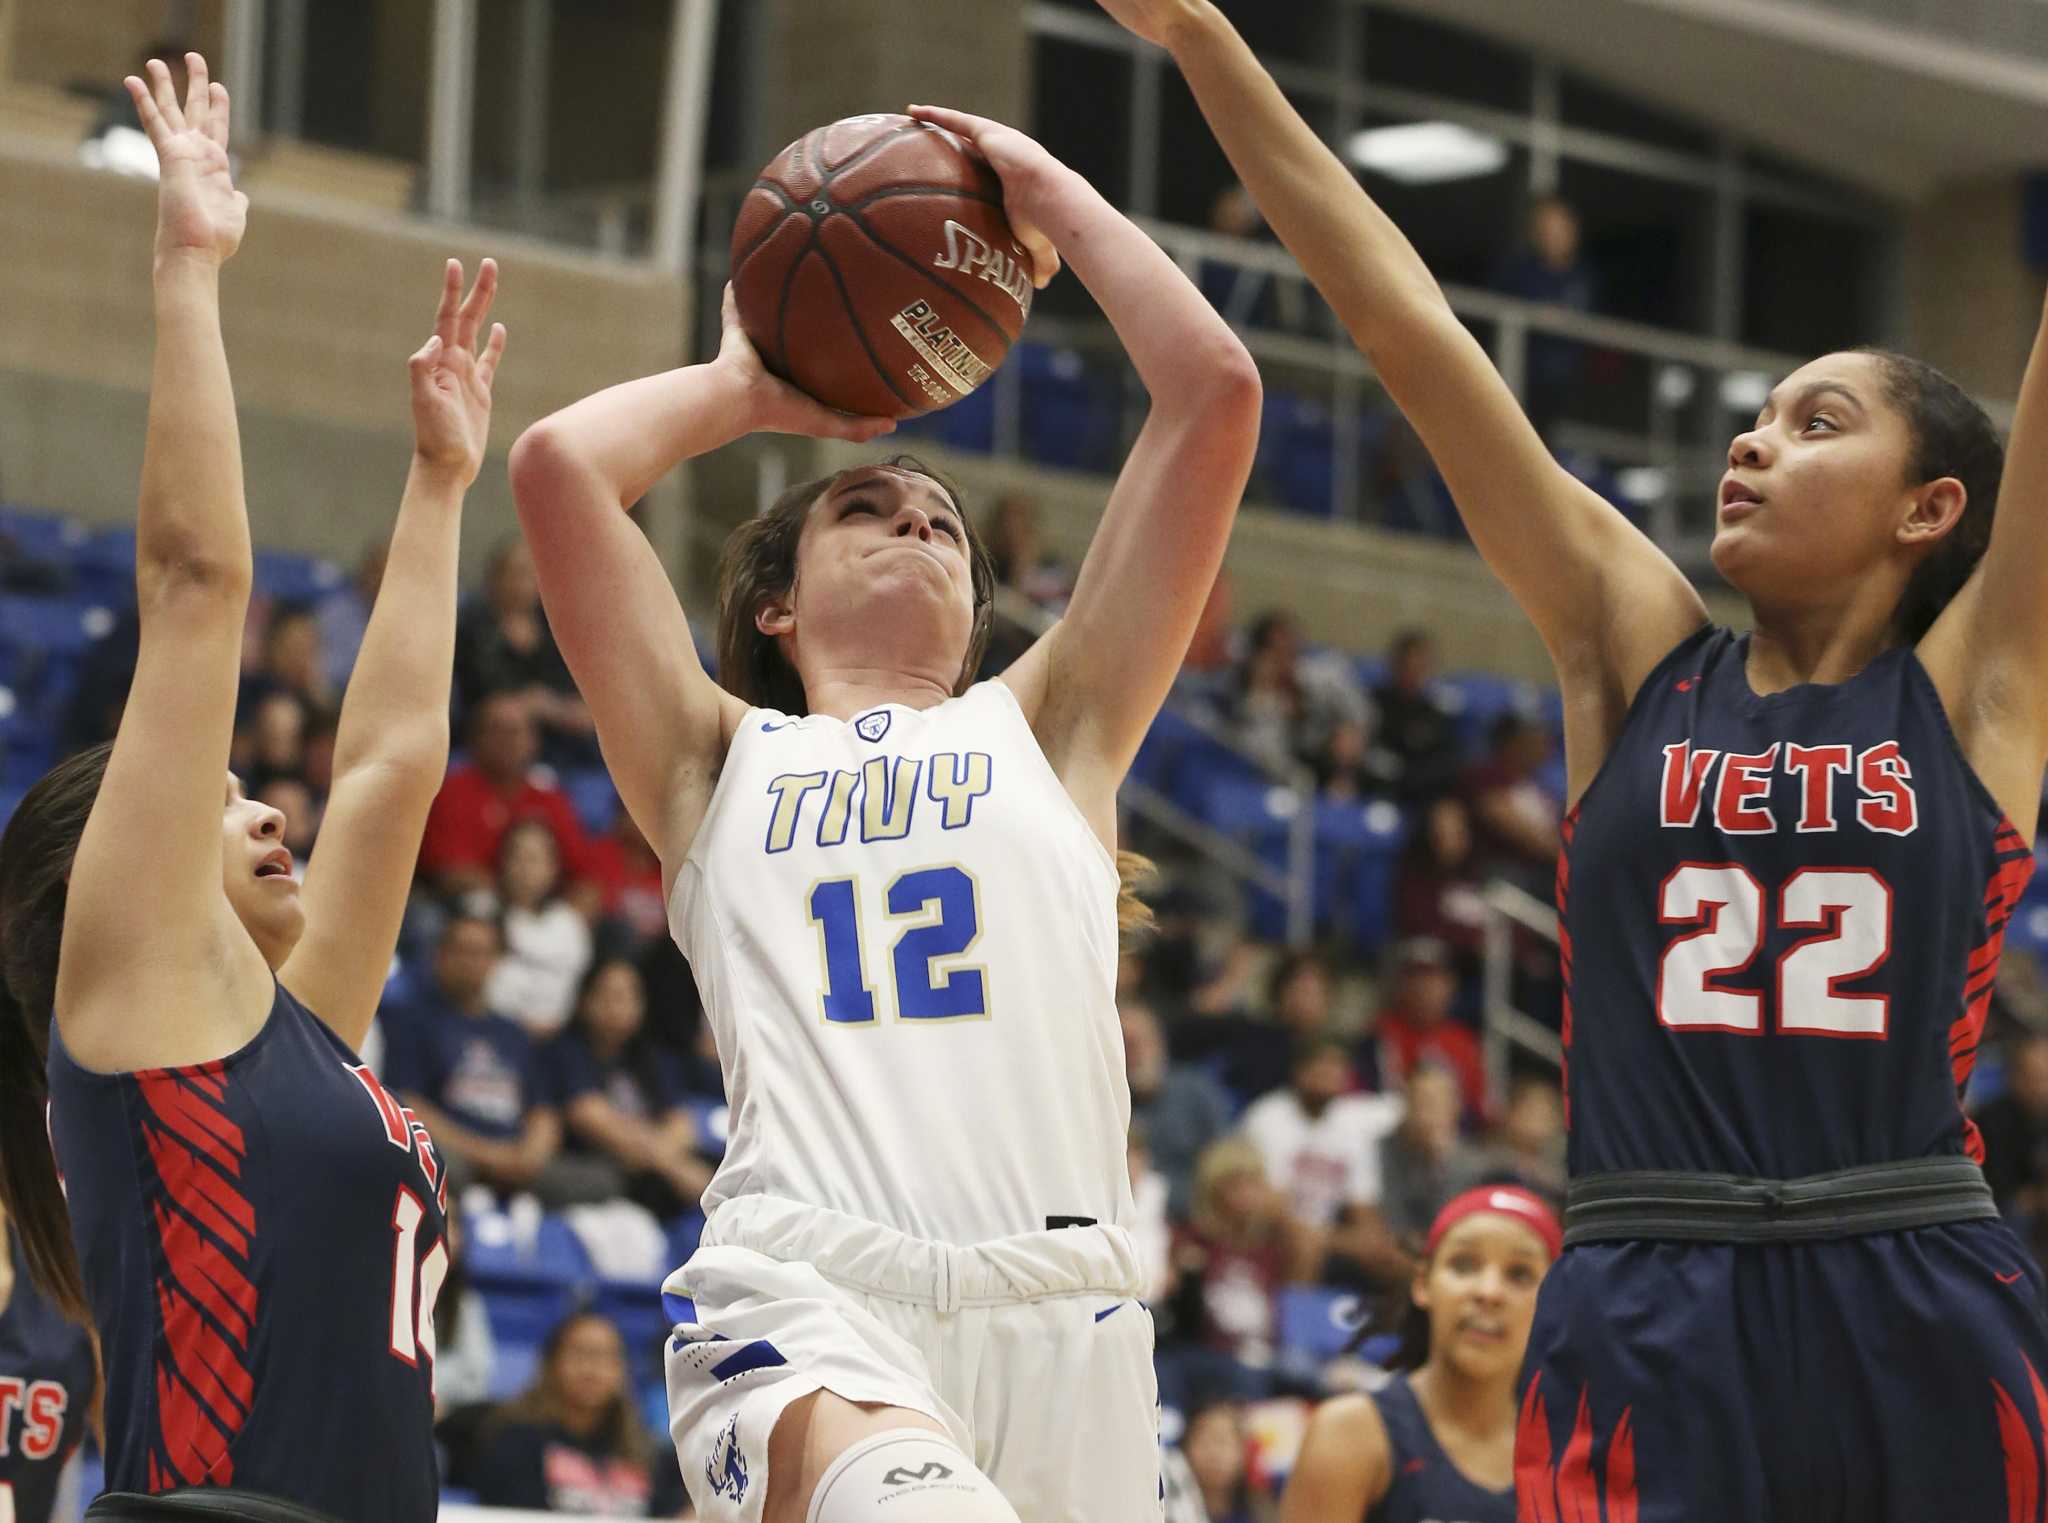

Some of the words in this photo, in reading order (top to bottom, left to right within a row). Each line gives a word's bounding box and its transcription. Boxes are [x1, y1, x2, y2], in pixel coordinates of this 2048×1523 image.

[765, 751, 992, 854] TIVY
[1660, 738, 1918, 837] VETS
[803, 861, 992, 1029] 12
[1656, 860, 1894, 1041] 22
[341, 1061, 448, 1216] VE
